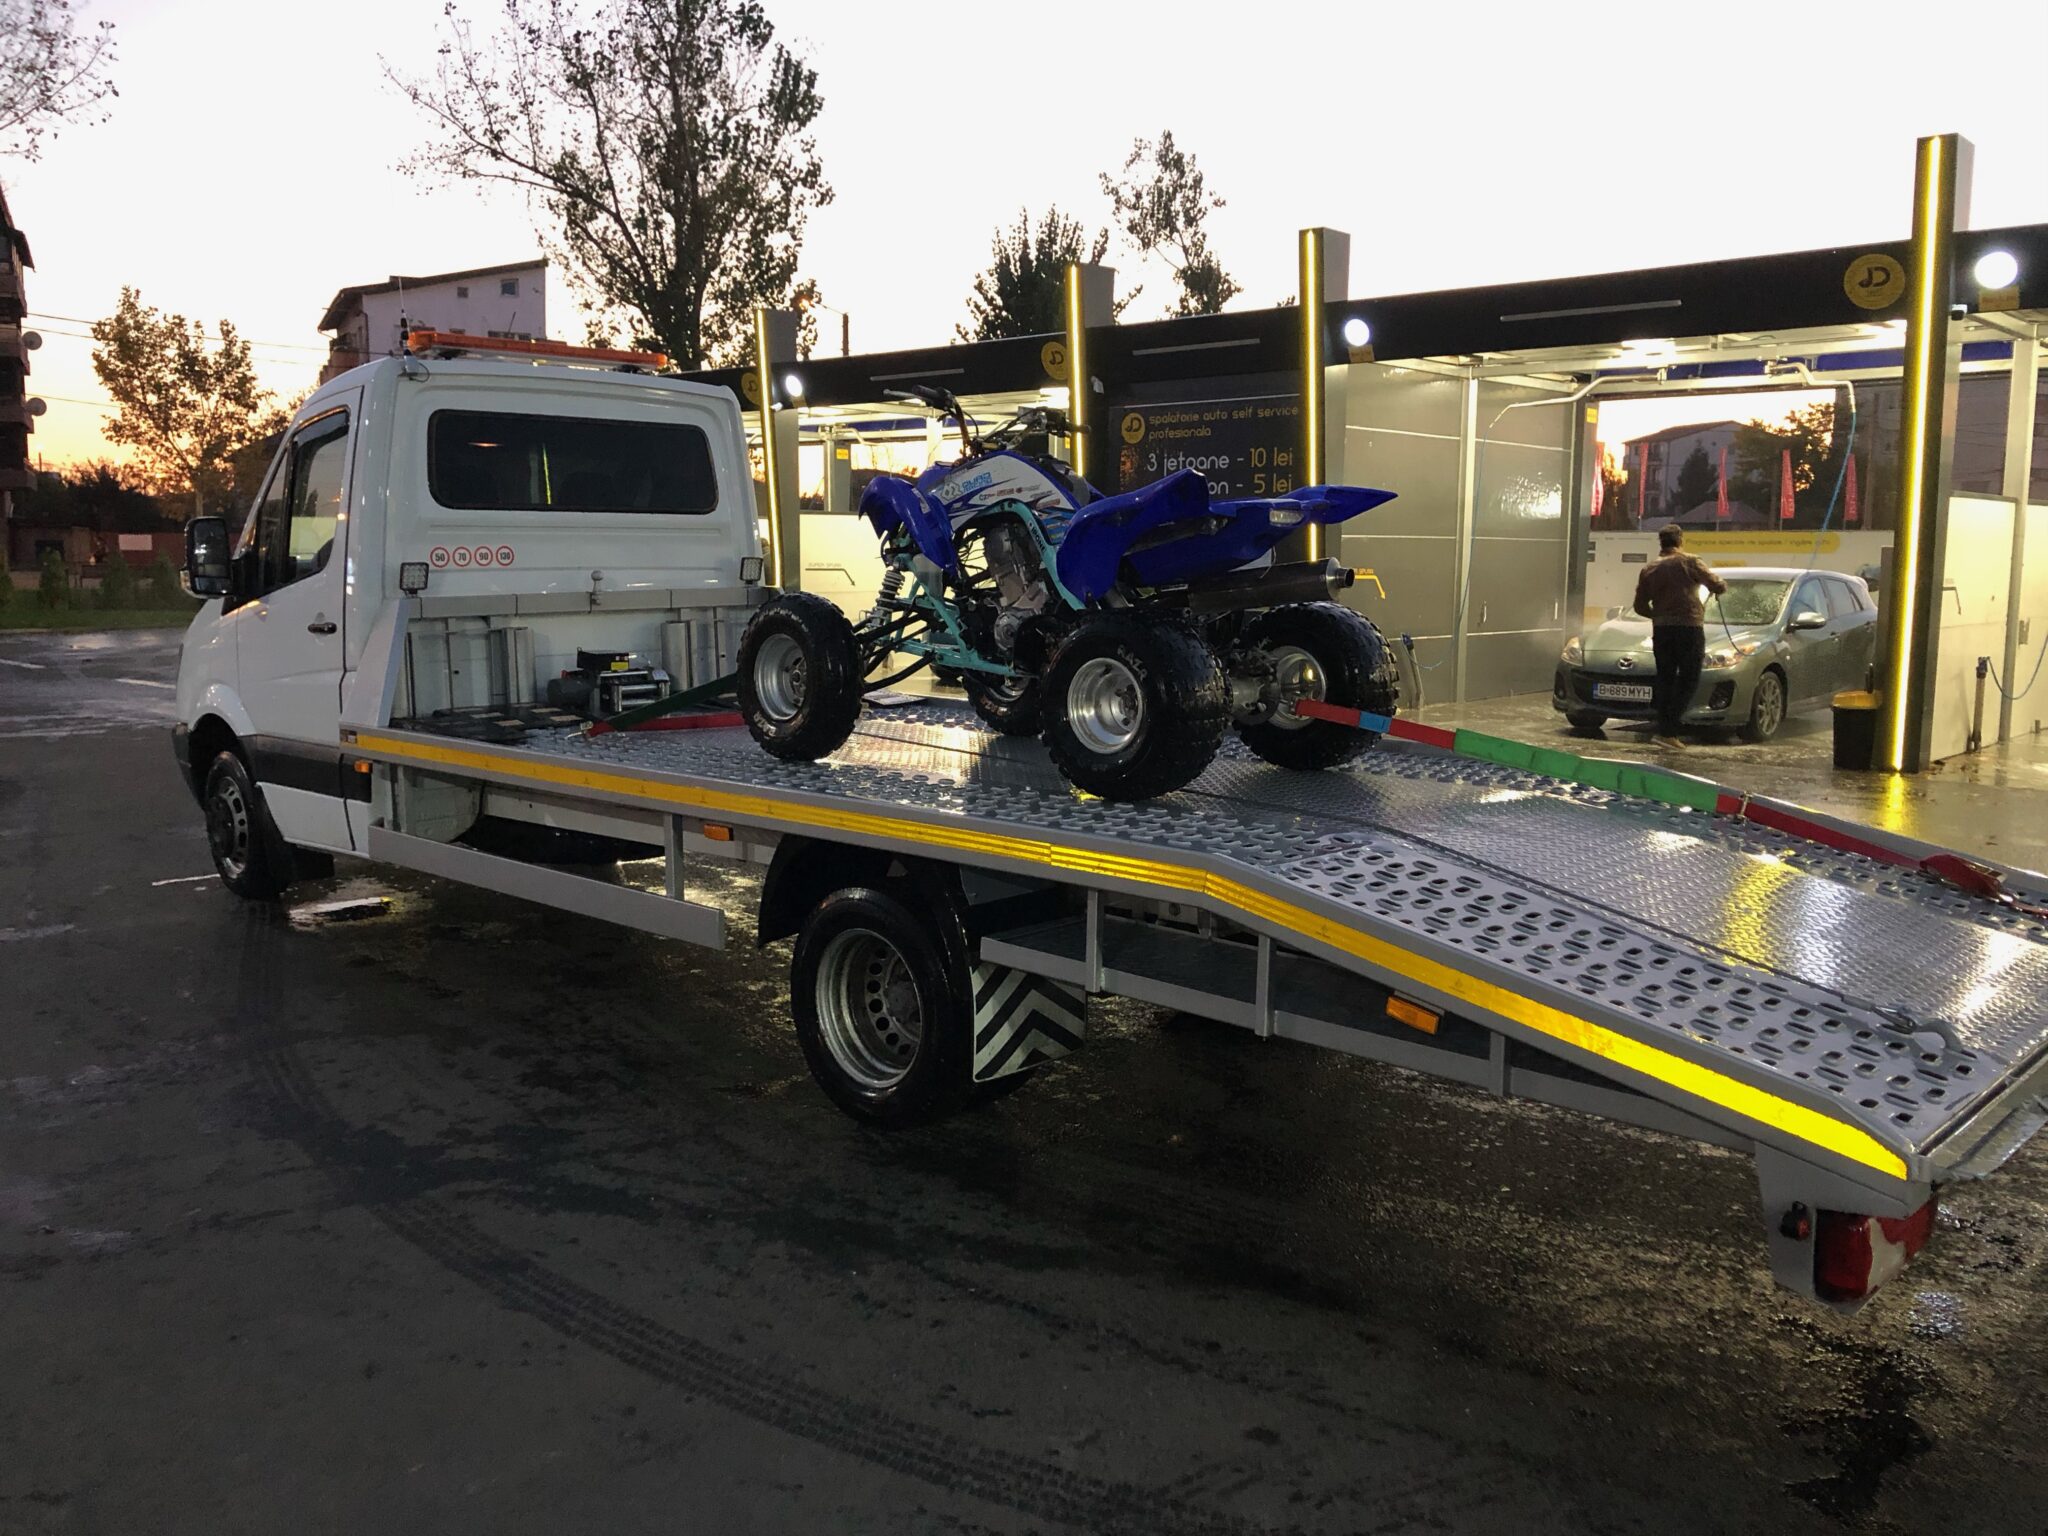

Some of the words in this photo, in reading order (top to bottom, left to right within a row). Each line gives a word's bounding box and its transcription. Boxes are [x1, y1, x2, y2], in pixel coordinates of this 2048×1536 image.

[1202, 408, 1228, 421] auto
[1231, 405, 1253, 420] self
[1257, 405, 1299, 418] service
[1148, 424, 1212, 442] profesionala
[1147, 453, 1158, 472] 3
[1163, 451, 1230, 477] jetoane
[1250, 447, 1267, 468] 10
[1273, 447, 1293, 467] lei
[1253, 473, 1266, 494] 5
[1272, 473, 1293, 494] lei
[435, 552, 446, 562] 50
[457, 552, 467, 562] 70
[478, 551, 489, 561] 90
[499, 551, 511, 561] 130
